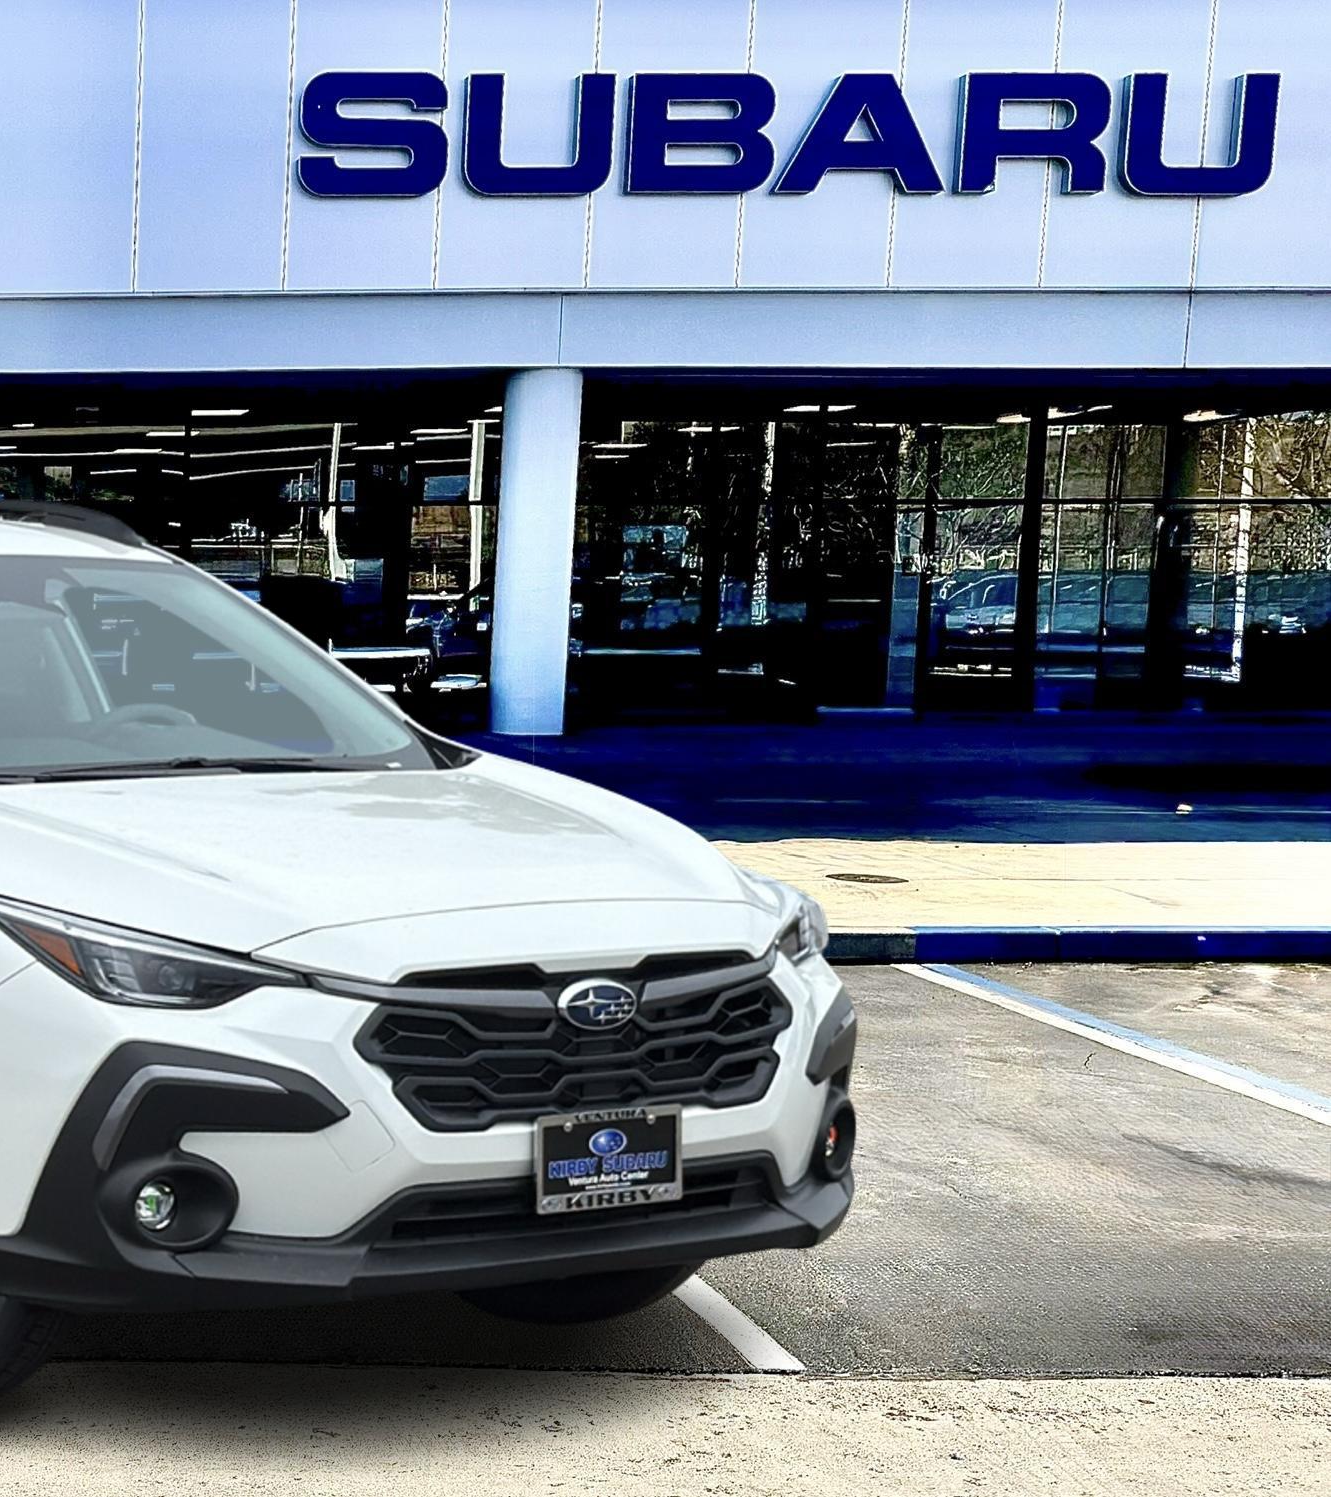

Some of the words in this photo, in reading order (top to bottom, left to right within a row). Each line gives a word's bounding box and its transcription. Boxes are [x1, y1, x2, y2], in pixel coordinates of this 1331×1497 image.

[296, 71, 1280, 200] SUBARU
[574, 1109, 647, 1123] VENTURA
[548, 1157, 598, 1180] KIRBY
[602, 1151, 668, 1172] SUBARU
[568, 1175, 598, 1186] Ventura
[599, 1173, 620, 1183] Auto
[621, 1170, 649, 1180] Center
[566, 1188, 655, 1209] KIRBY
